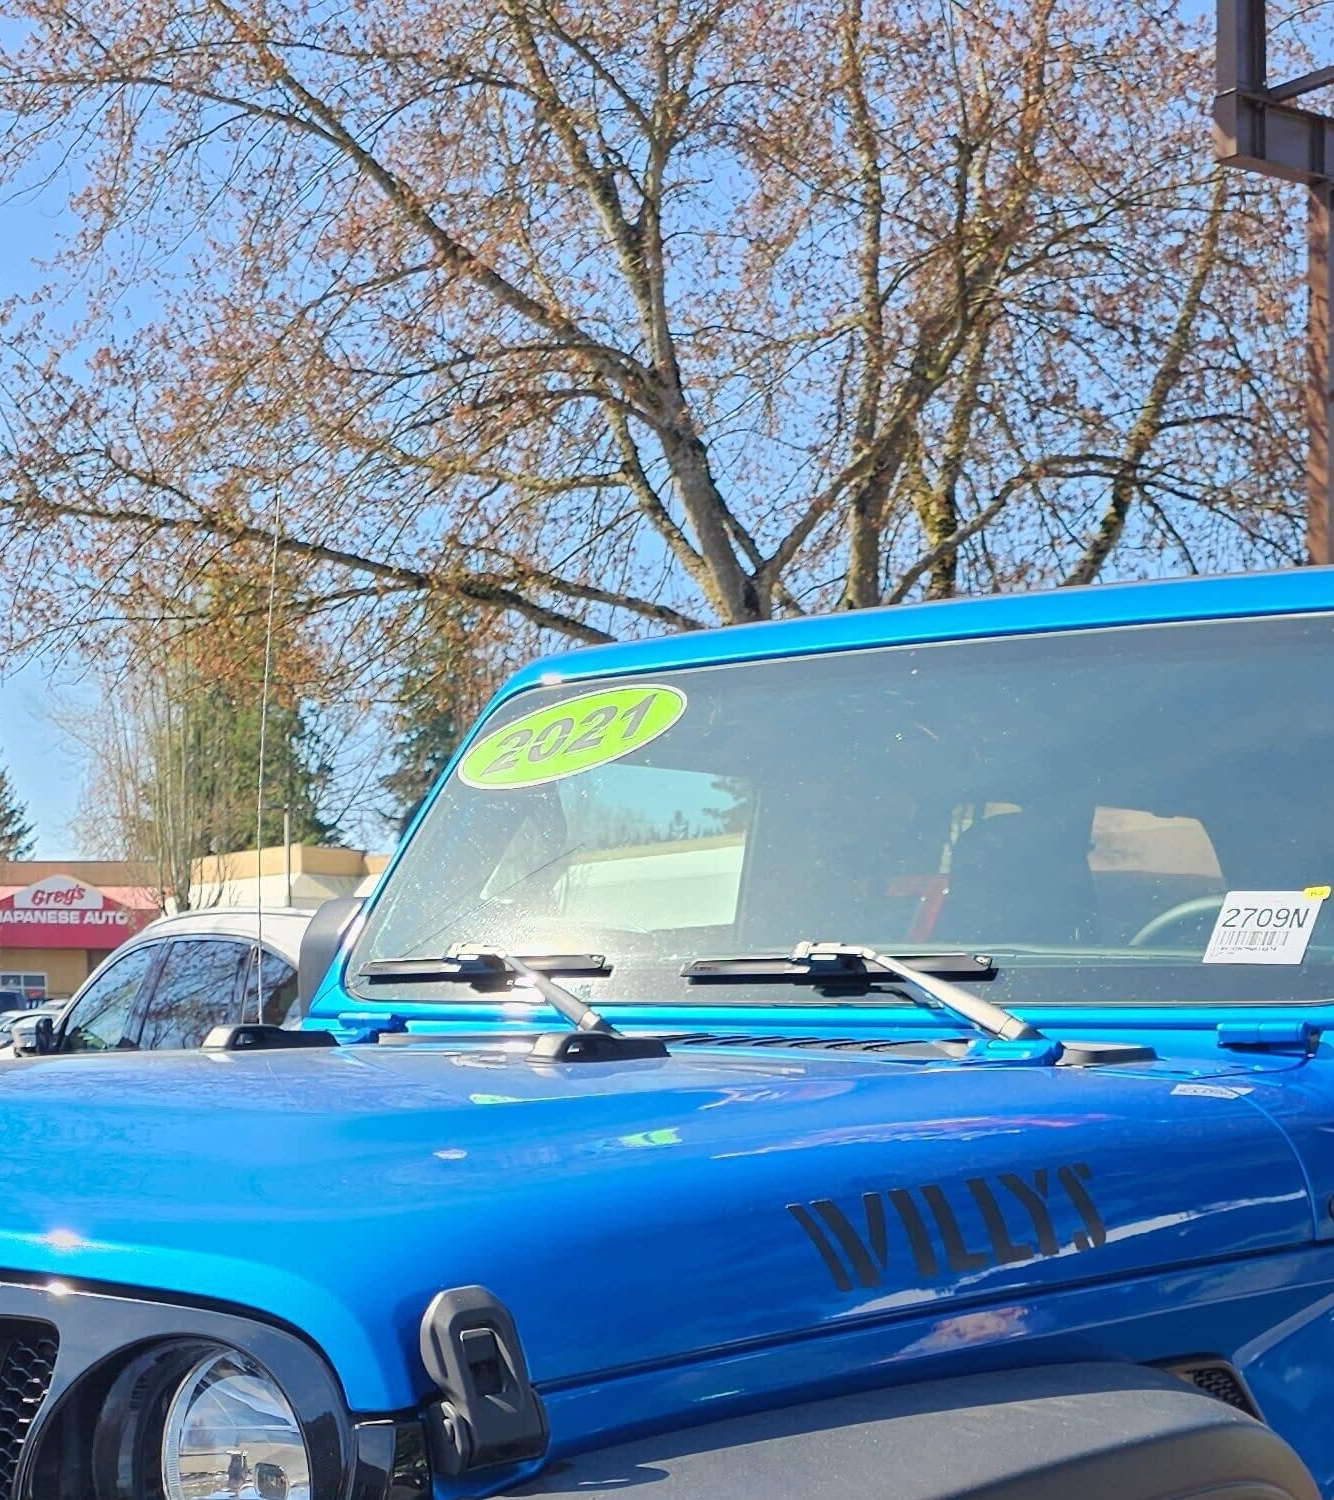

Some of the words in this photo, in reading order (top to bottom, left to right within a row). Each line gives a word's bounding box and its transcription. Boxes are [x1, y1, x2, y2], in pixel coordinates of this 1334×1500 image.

[480, 692, 658, 777] 2021
[31, 884, 85, 905] Greg's
[83, 911, 128, 925] AUTO
[1221, 908, 1310, 928] 2709N
[785, 1162, 1107, 1292] WILLYS
